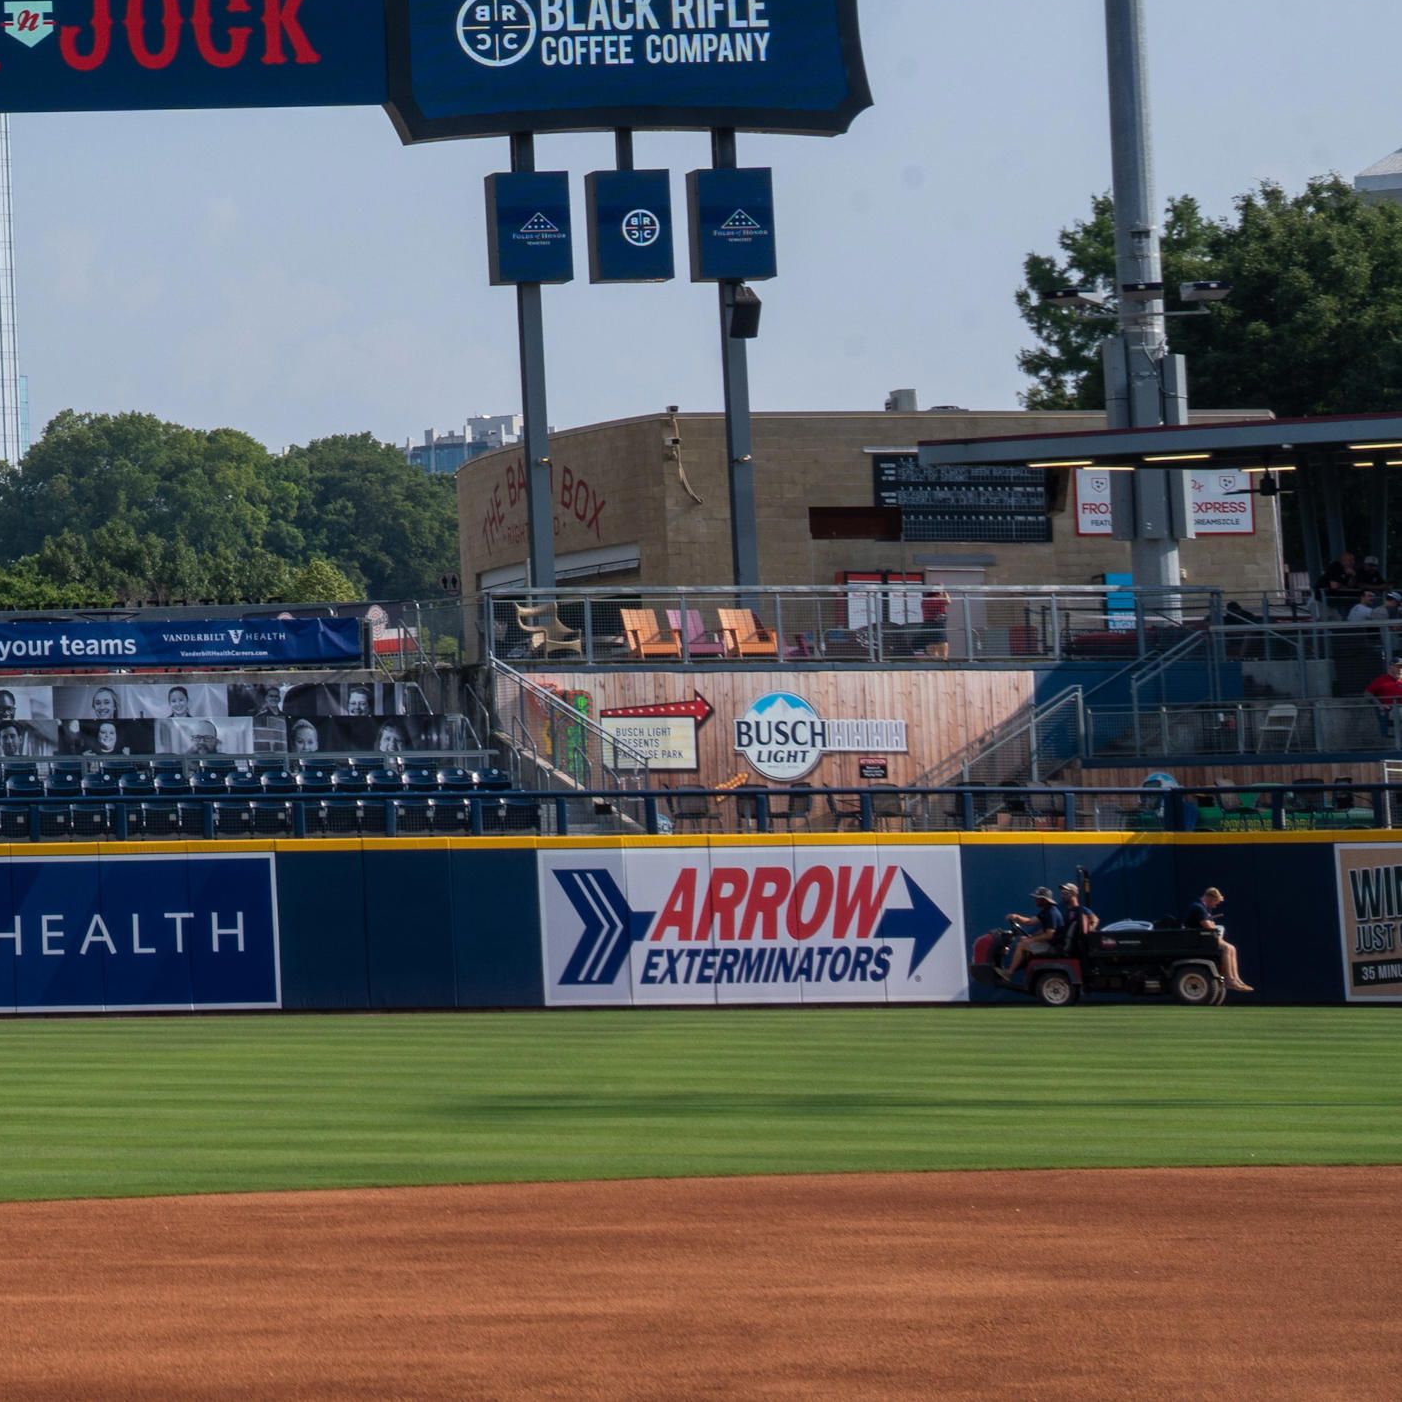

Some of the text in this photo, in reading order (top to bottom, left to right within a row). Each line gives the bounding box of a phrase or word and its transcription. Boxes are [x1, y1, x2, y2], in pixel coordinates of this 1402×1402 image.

[541, 32, 770, 66] COFFEE COMPANY
[482, 483, 504, 556] THE
[560, 465, 606, 540] BOX
[60, 635, 137, 655] teams
[162, 632, 286, 642] VANDERBILT HEALTH
[616, 727, 671, 737] BUSCH LIGHT
[617, 739, 660, 748] RESENTS
[662, 749, 684, 759] PARK
[757, 749, 810, 763] LIGHT
[650, 864, 899, 941] ARROW
[1355, 923, 1395, 953] JUST
[640, 945, 894, 985] EXTERMINATORS
[1361, 965, 1376, 981] 35
